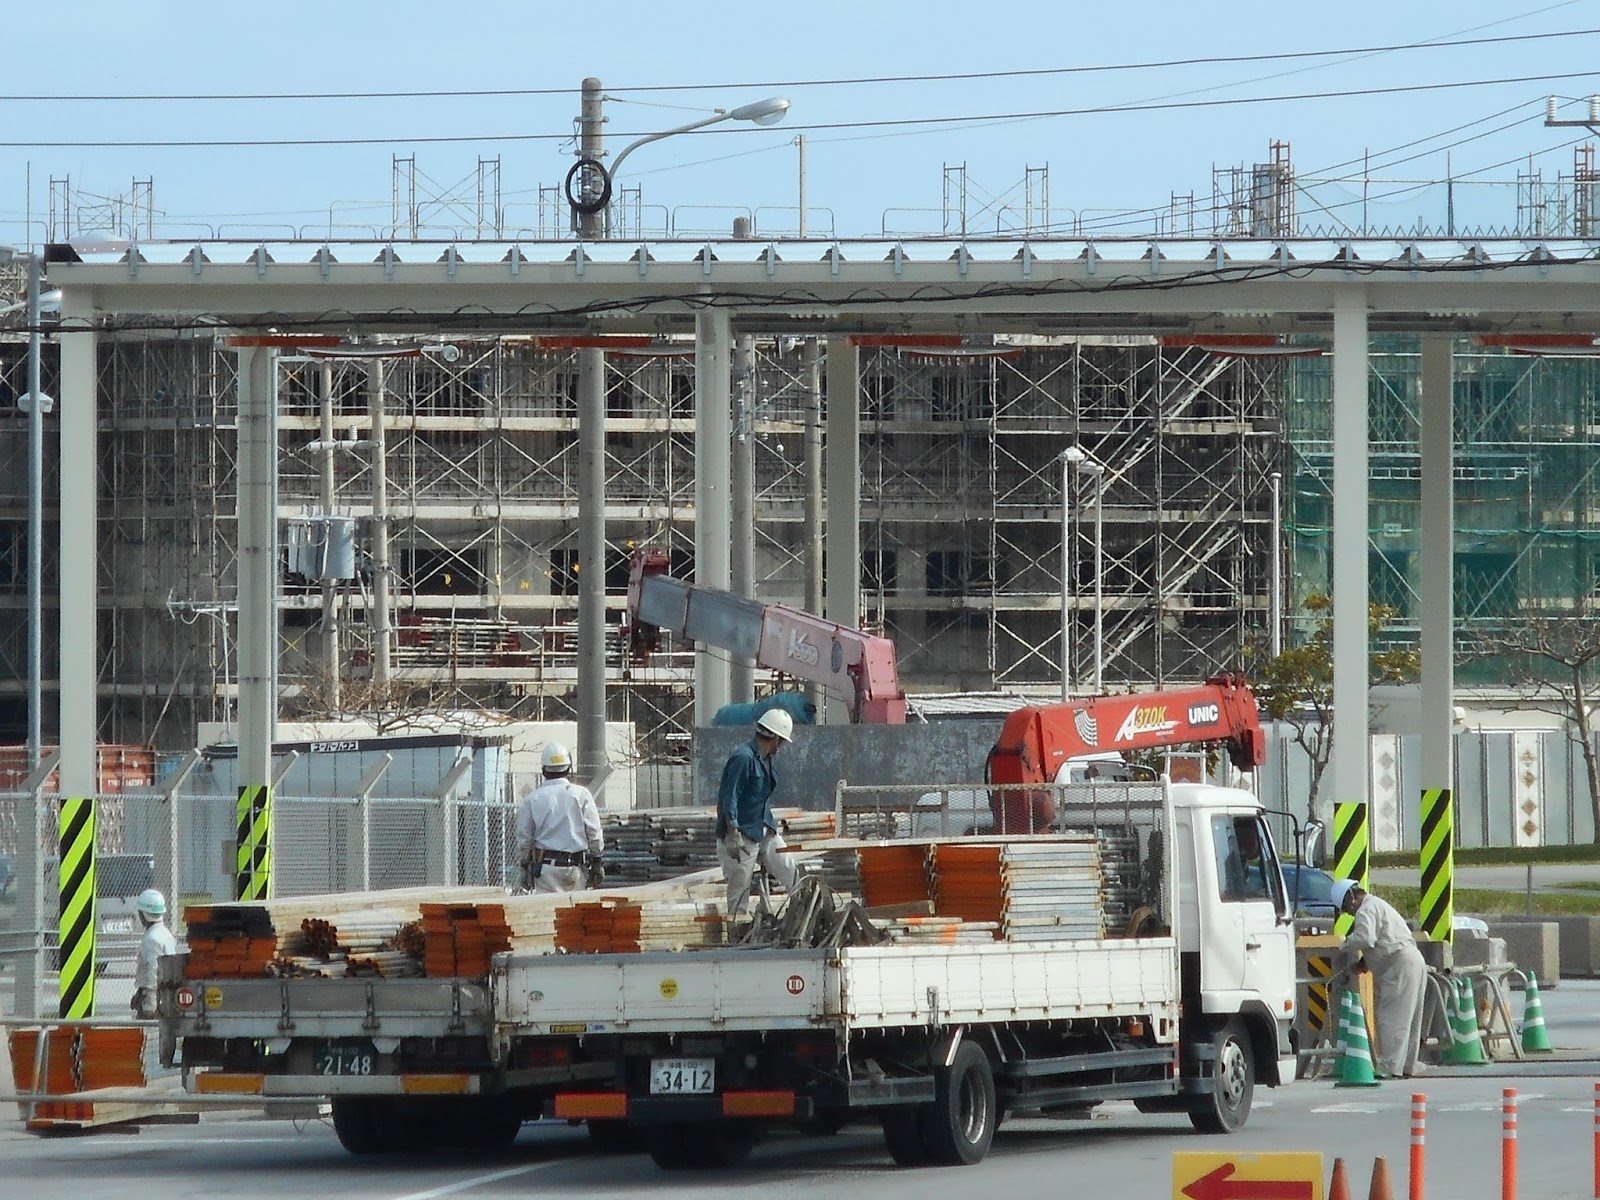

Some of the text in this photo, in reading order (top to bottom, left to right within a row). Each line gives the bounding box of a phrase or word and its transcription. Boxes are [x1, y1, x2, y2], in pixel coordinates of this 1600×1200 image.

[1189, 705, 1219, 724] UNIC
[323, 1055, 371, 1075] 21-48
[662, 1071, 711, 1090] 34-12
